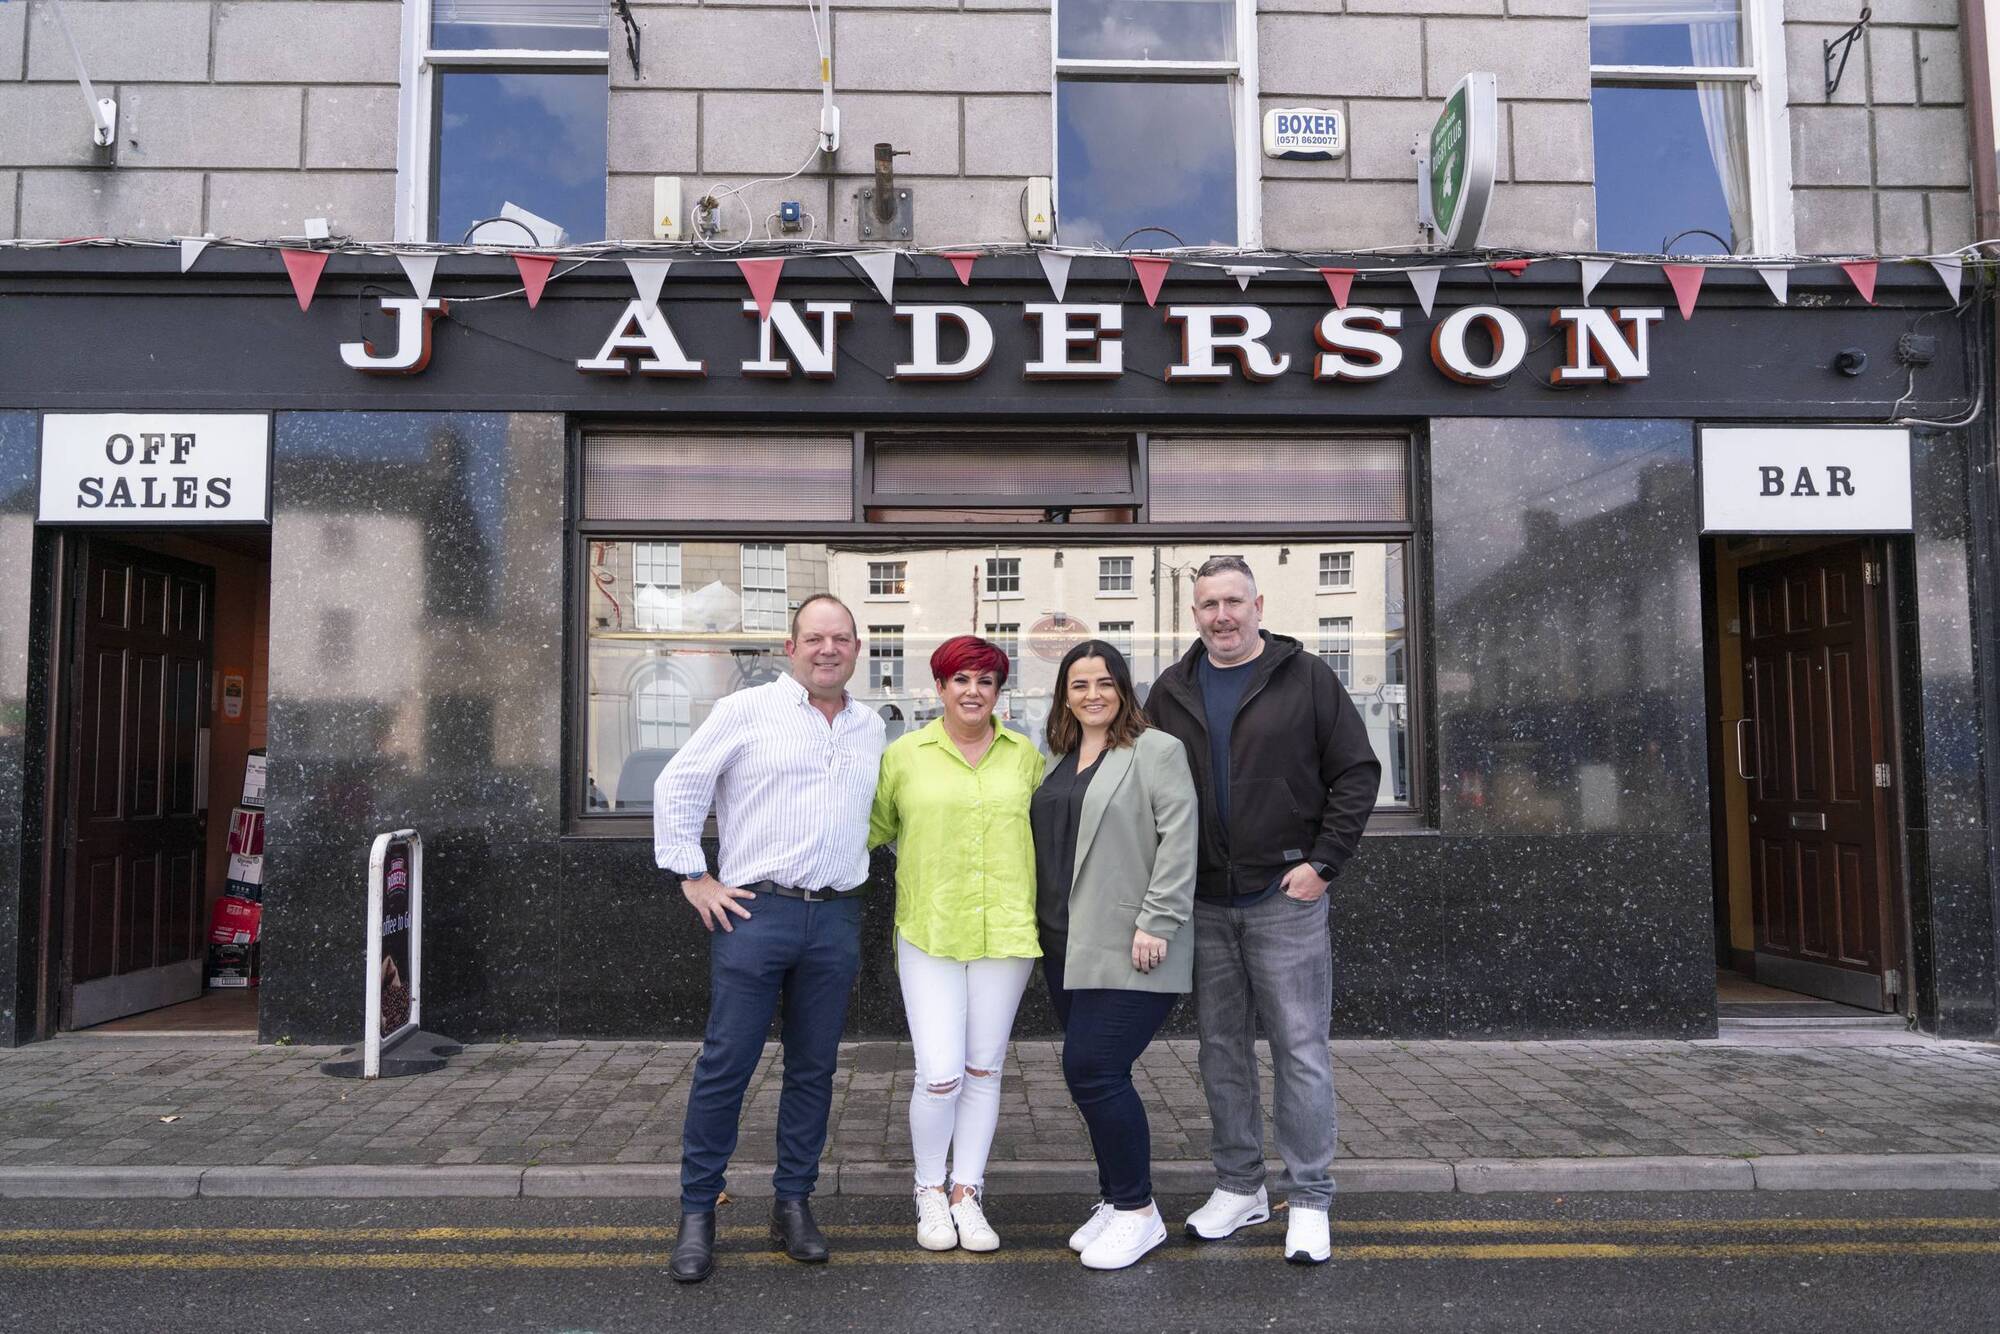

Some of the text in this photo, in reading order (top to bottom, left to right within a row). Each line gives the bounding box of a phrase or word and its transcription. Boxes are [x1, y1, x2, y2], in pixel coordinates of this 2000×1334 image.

[1277, 114, 1337, 135] BOXER
[1447, 119, 1462, 149] CLUB
[1276, 135, 1338, 146] (057) 8620077
[340, 297, 1665, 384] J ANDERSON
[105, 433, 196, 465] OFF
[77, 477, 232, 508] SALES
[1758, 466, 1855, 497] BAR
[382, 914, 397, 936] offee
[397, 913, 404, 931] to
